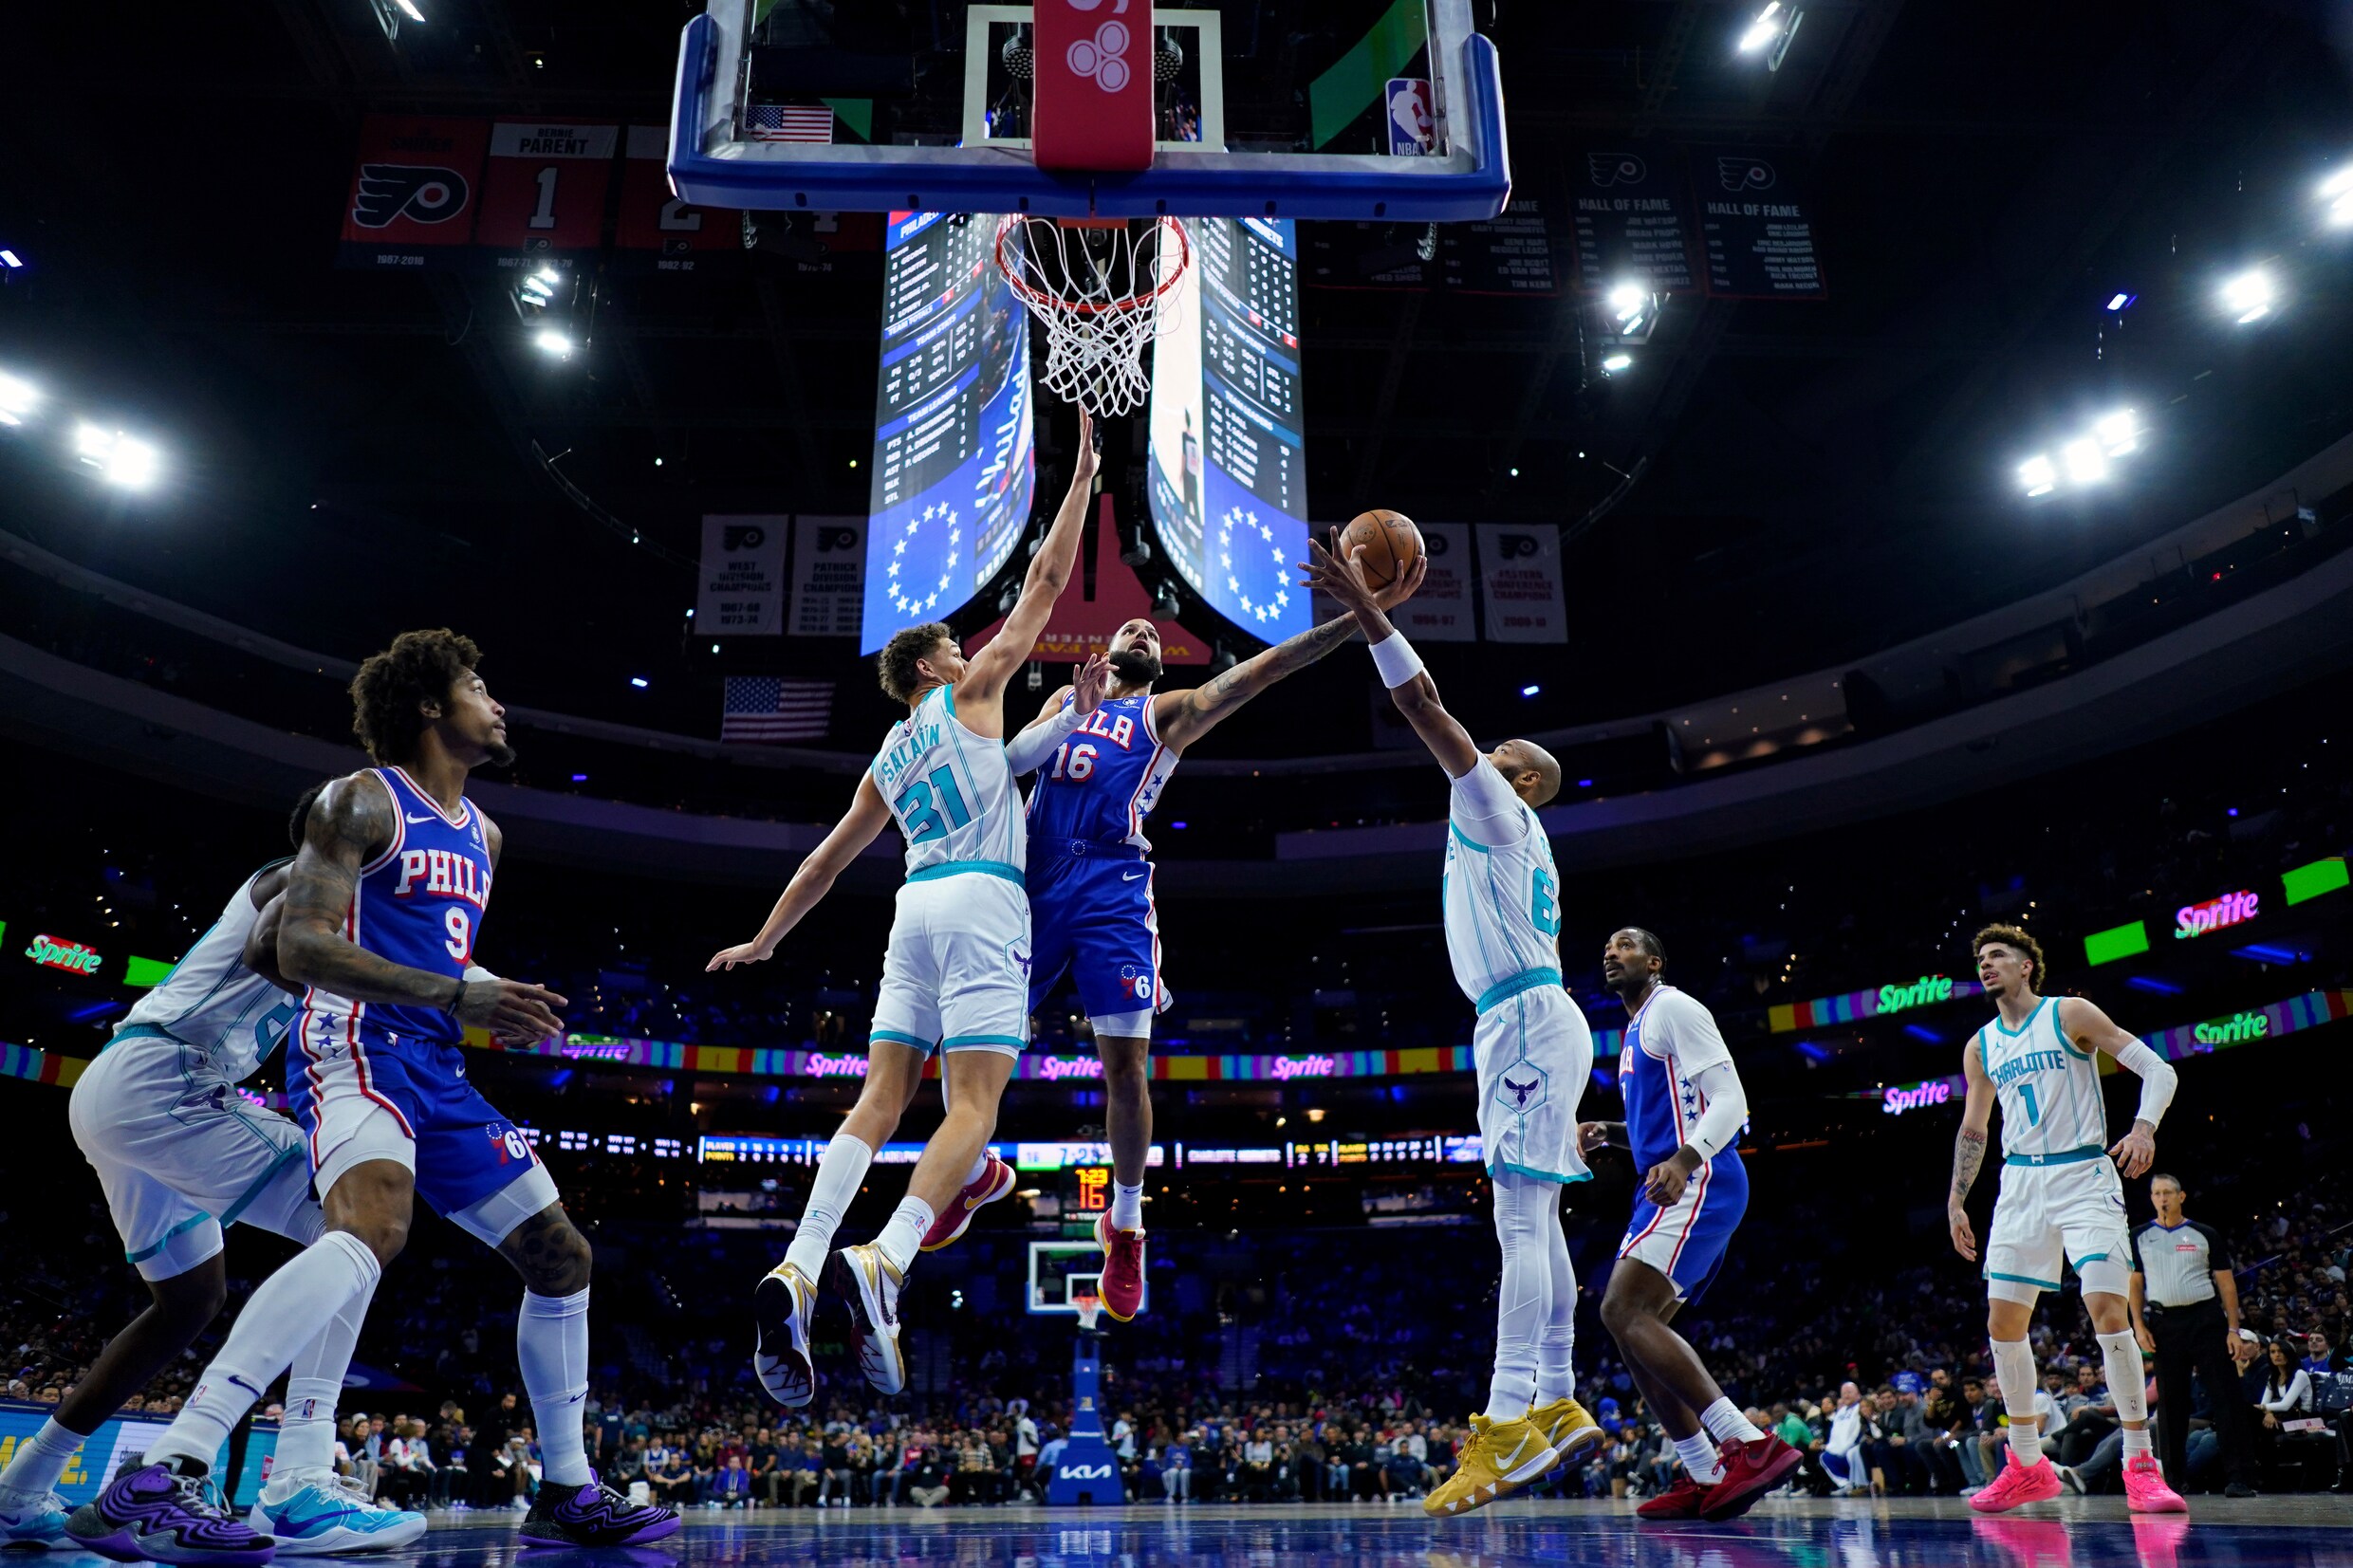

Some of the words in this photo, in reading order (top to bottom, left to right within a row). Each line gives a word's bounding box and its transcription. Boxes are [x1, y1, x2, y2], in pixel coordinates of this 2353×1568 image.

[519, 138, 588, 155] PARENT
[1397, 142, 1420, 156] NBA
[529, 167, 558, 229] 1
[1509, 200, 1539, 212] AME
[1579, 198, 1612, 211] HALL
[1613, 198, 1631, 211] OF
[1633, 198, 1671, 211] FAME
[1707, 202, 1742, 215] HALL
[1743, 203, 1760, 216] OF
[1762, 204, 1801, 217] FAME
[901, 244, 927, 265] GEORGE
[899, 262, 939, 291] DRUMMOND
[900, 257, 927, 278] MARTIN
[890, 301, 896, 309] 9
[899, 286, 921, 304] OUBRE
[898, 299, 922, 318] LOWRY
[888, 320, 909, 336] TEAM
[909, 304, 933, 324] TOTALS
[916, 328, 936, 346] TEAM
[936, 313, 957, 334] STATS
[1227, 319, 1246, 339] TEAM
[1245, 334, 1266, 355] STATS
[891, 366, 902, 378] FG
[908, 354, 923, 368] 2/6
[955, 322, 968, 336] STL
[886, 378, 901, 393] 3PT
[907, 367, 922, 381] 0/3
[932, 353, 945, 366] 0%
[889, 392, 900, 404] FT
[927, 364, 948, 382] 100%
[955, 348, 967, 361] TO
[1267, 367, 1280, 380] STL
[907, 404, 929, 424] TEAM
[929, 385, 958, 413] LEADERS
[1225, 390, 1244, 412] TEAM
[1269, 394, 1281, 406] TO
[1285, 403, 1291, 413] 2
[886, 436, 902, 451] PTS
[1280, 445, 1290, 456] 10
[884, 464, 900, 478] AST
[884, 477, 899, 491] BLK
[884, 491, 899, 505] STL
[729, 562, 757, 571] WEST
[812, 572, 857, 581] DIVISION
[814, 563, 857, 572] PATRICK
[1498, 569, 1543, 580] EASTERN
[1491, 580, 1553, 590] CONFERENCE
[1494, 590, 1552, 600] CHAMPIONS
[1078, 710, 1131, 751] ILA
[1050, 743, 1099, 783] 16
[893, 763, 972, 845] 31
[2175, 892, 2260, 939] Sprite
[444, 906, 472, 964] 9
[25, 934, 103, 973] Sprite
[1120, 974, 1152, 1000] 76
[1878, 975, 1954, 1015] Sprite
[2194, 1012, 2269, 1045] Sprite
[806, 1053, 869, 1078] Sprite
[1039, 1055, 1102, 1080] Sprite
[1271, 1054, 1335, 1080] Sprite
[1991, 1049, 2066, 1090] CHARLOTTE
[1883, 1081, 1950, 1115] Sprite
[2018, 1083, 2040, 1127] 1
[490, 1129, 528, 1167] 76
[705, 1141, 735, 1151] PLAYER
[705, 1151, 735, 1161] POINTS
[1075, 1169, 1108, 1184] 7:23
[1080, 1184, 1105, 1209] 16
